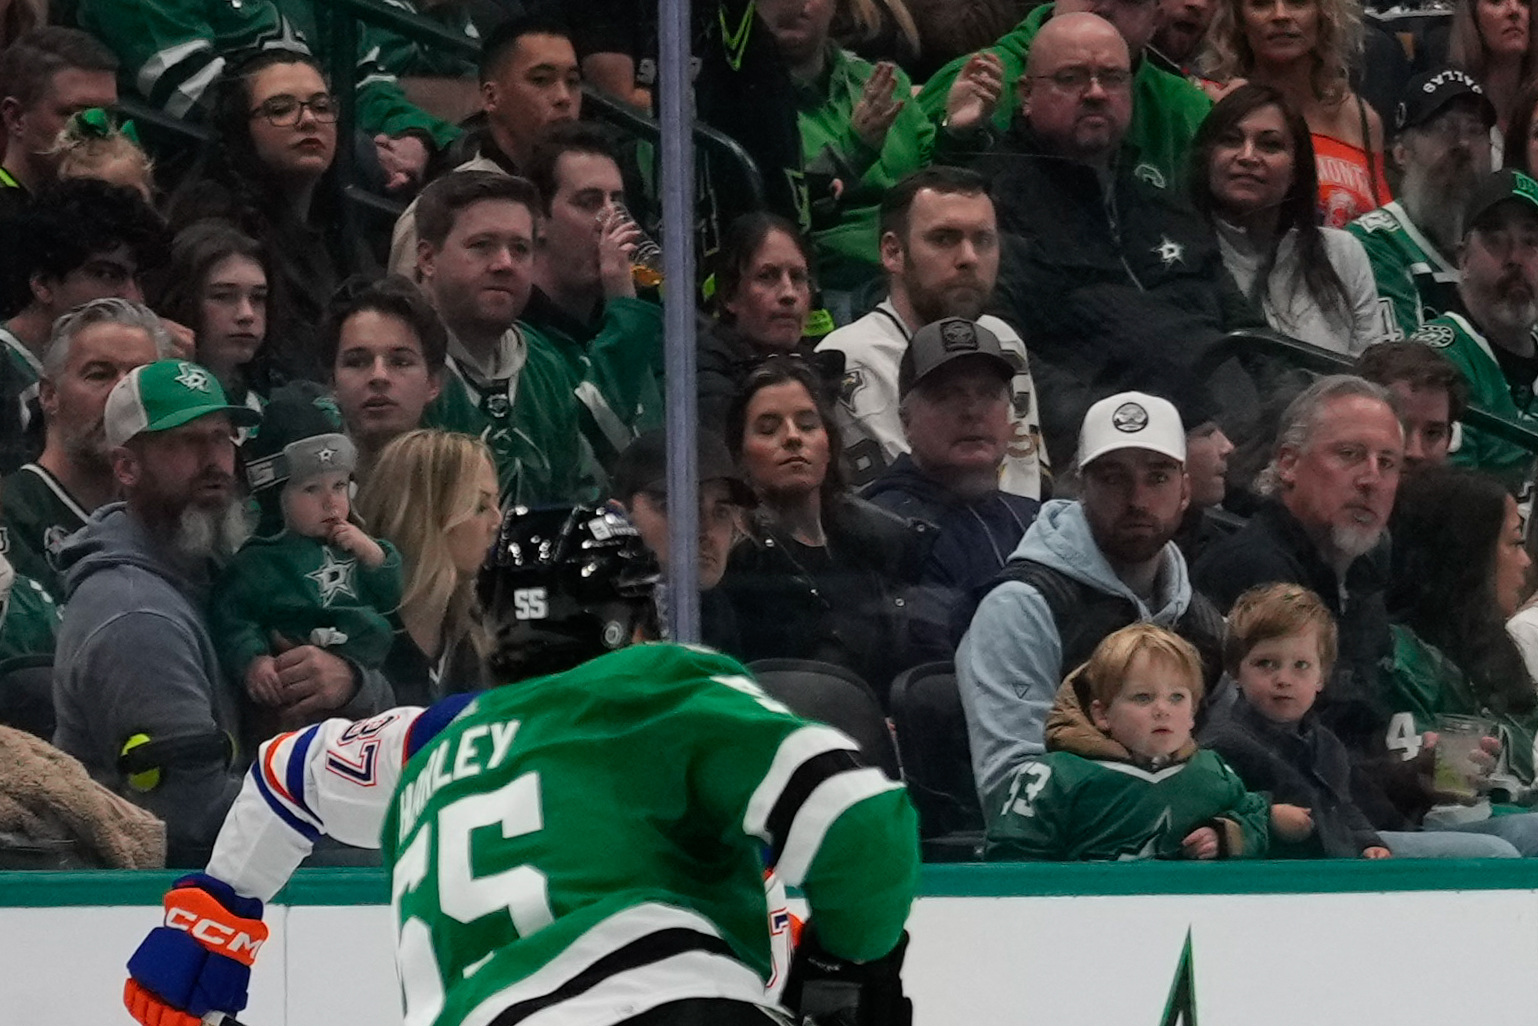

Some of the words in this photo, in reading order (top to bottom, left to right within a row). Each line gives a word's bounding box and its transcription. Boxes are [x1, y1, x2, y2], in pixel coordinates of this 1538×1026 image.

[1422, 70, 1484, 95] DALLAS
[514, 586, 548, 620] 55
[166, 907, 265, 959] CCM
